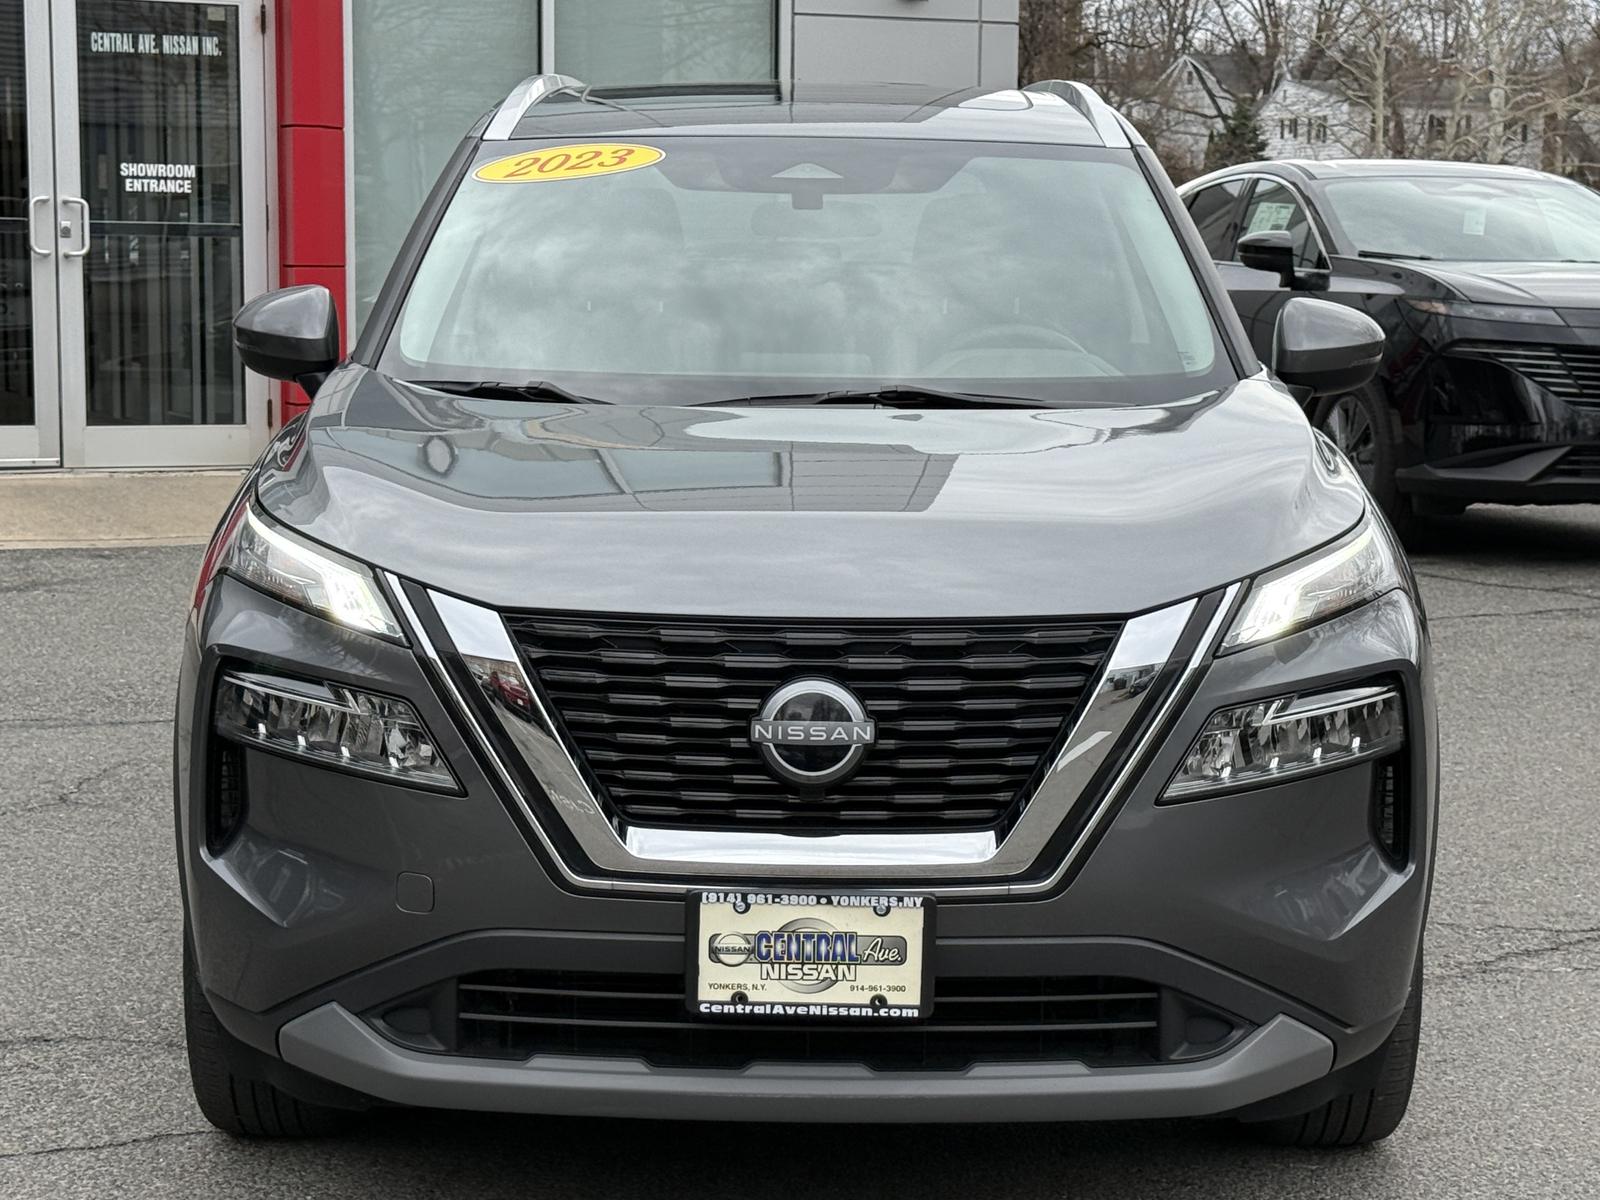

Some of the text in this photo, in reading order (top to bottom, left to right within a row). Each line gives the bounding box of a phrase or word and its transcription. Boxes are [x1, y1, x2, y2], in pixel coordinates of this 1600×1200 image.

[91, 31, 222, 56] CENTRAL AVE. NISSAN INC.
[120, 162, 196, 178] SHOWROOM
[503, 148, 635, 178] 2023
[125, 178, 192, 194] ENTRANCE
[754, 724, 871, 741] NISSAN
[747, 893, 817, 905] 961-3900
[714, 945, 750, 953] NISSAN
[756, 931, 902, 964] CENTRAL Ave.
[760, 963, 857, 981] NISSAN
[708, 983, 767, 991] YONKERS, N.Y.
[700, 1003, 919, 1017] CentralAveNissan.com
